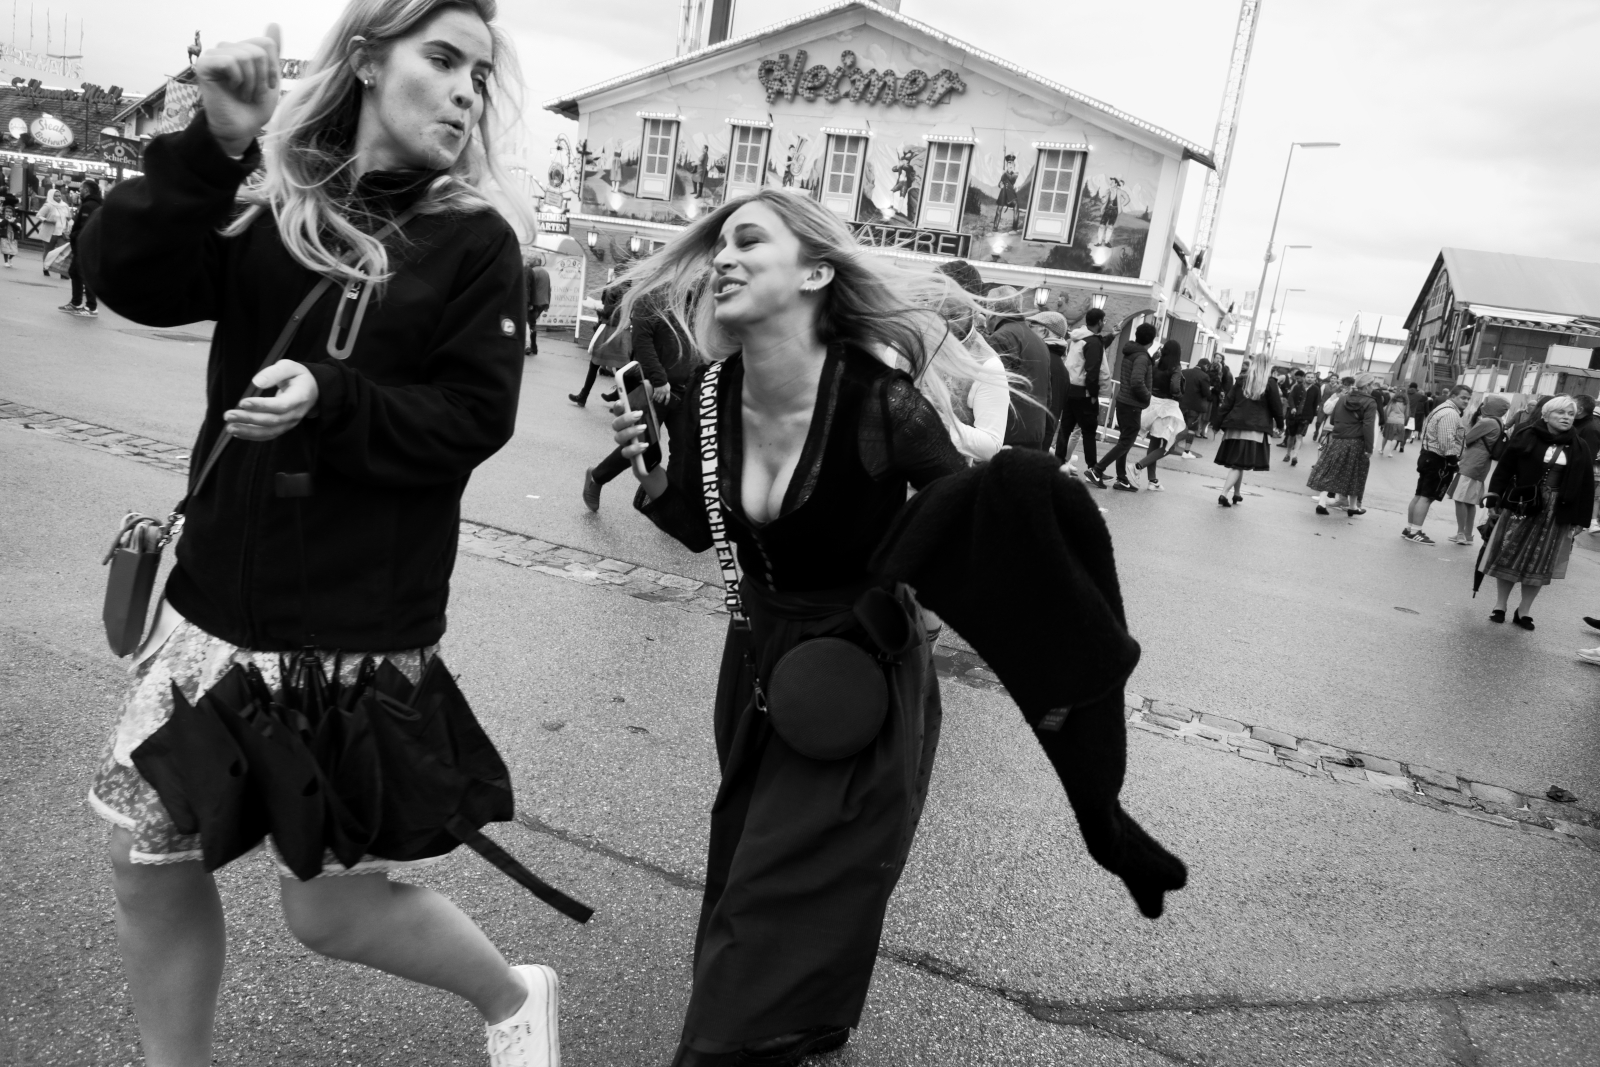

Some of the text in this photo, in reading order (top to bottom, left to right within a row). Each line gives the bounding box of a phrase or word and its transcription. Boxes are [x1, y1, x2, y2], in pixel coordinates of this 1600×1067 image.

[757, 49, 968, 107] Heimer
[38, 119, 66, 135] Steak
[34, 131, 69, 146] Bratwurst
[103, 151, 137, 166] Schießen
[703, 465, 735, 570] TRACHTEN
